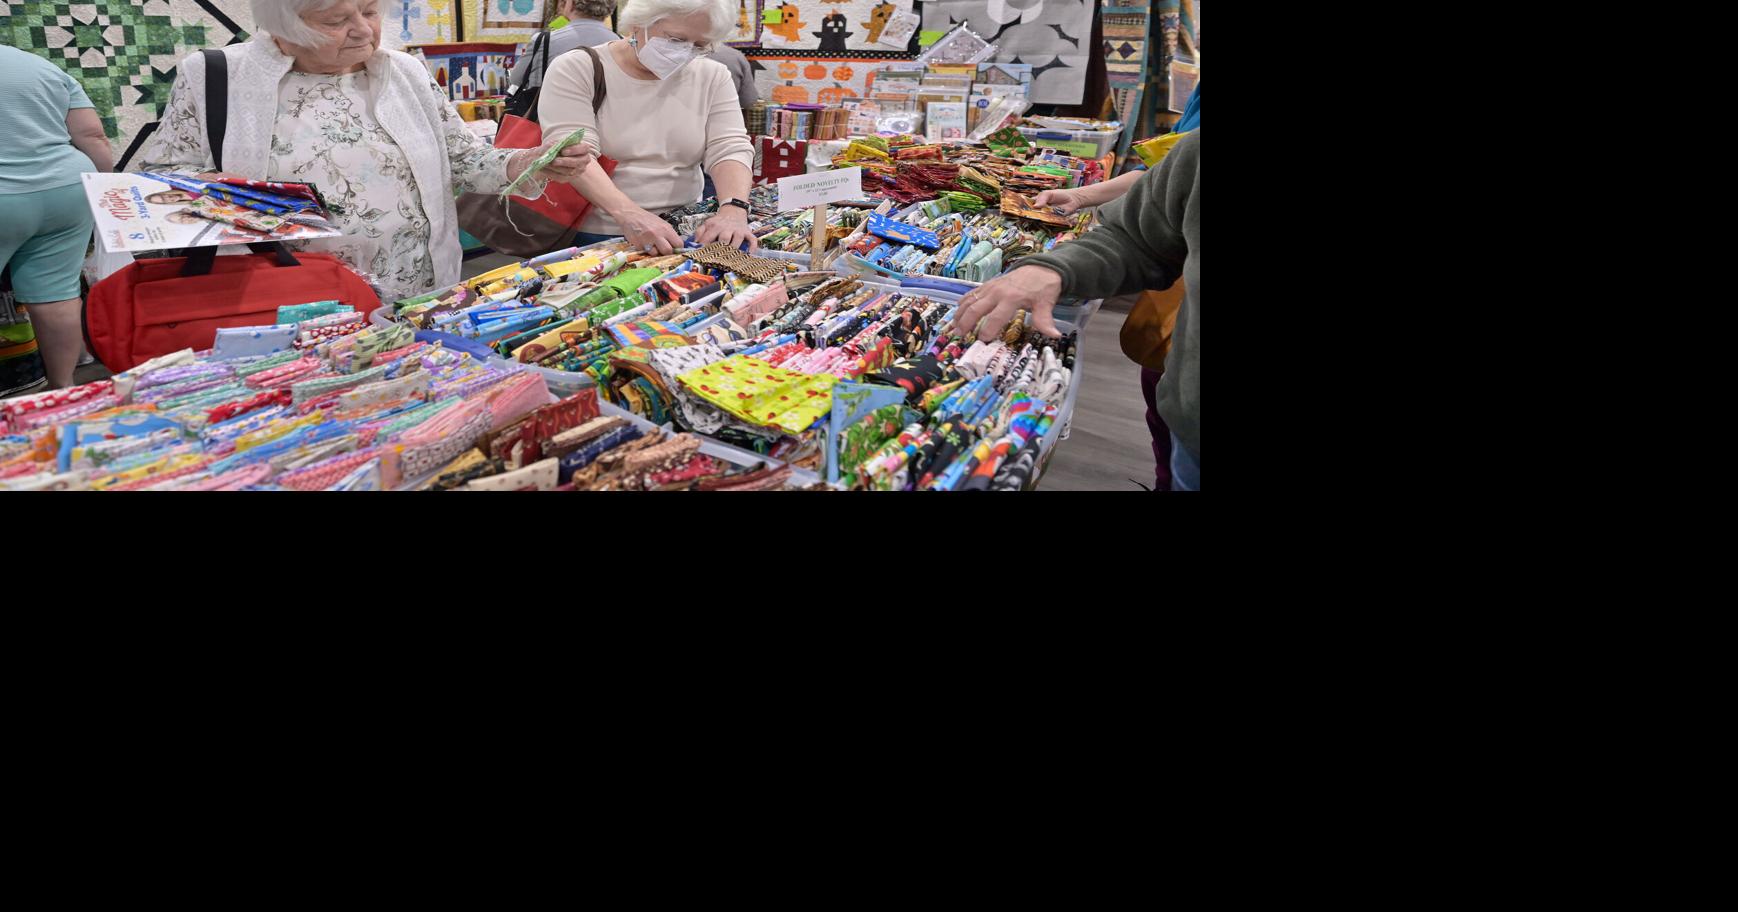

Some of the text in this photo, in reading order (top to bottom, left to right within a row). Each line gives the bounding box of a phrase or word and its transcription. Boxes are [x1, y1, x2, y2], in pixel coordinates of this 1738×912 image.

[793, 183, 816, 191] FOLDED
[816, 178, 840, 188] NOVELTY
[130, 186, 142, 201] Quilts
[104, 190, 135, 221] Magic
[137, 201, 151, 219] 3-Yard
[128, 232, 145, 240] 8
